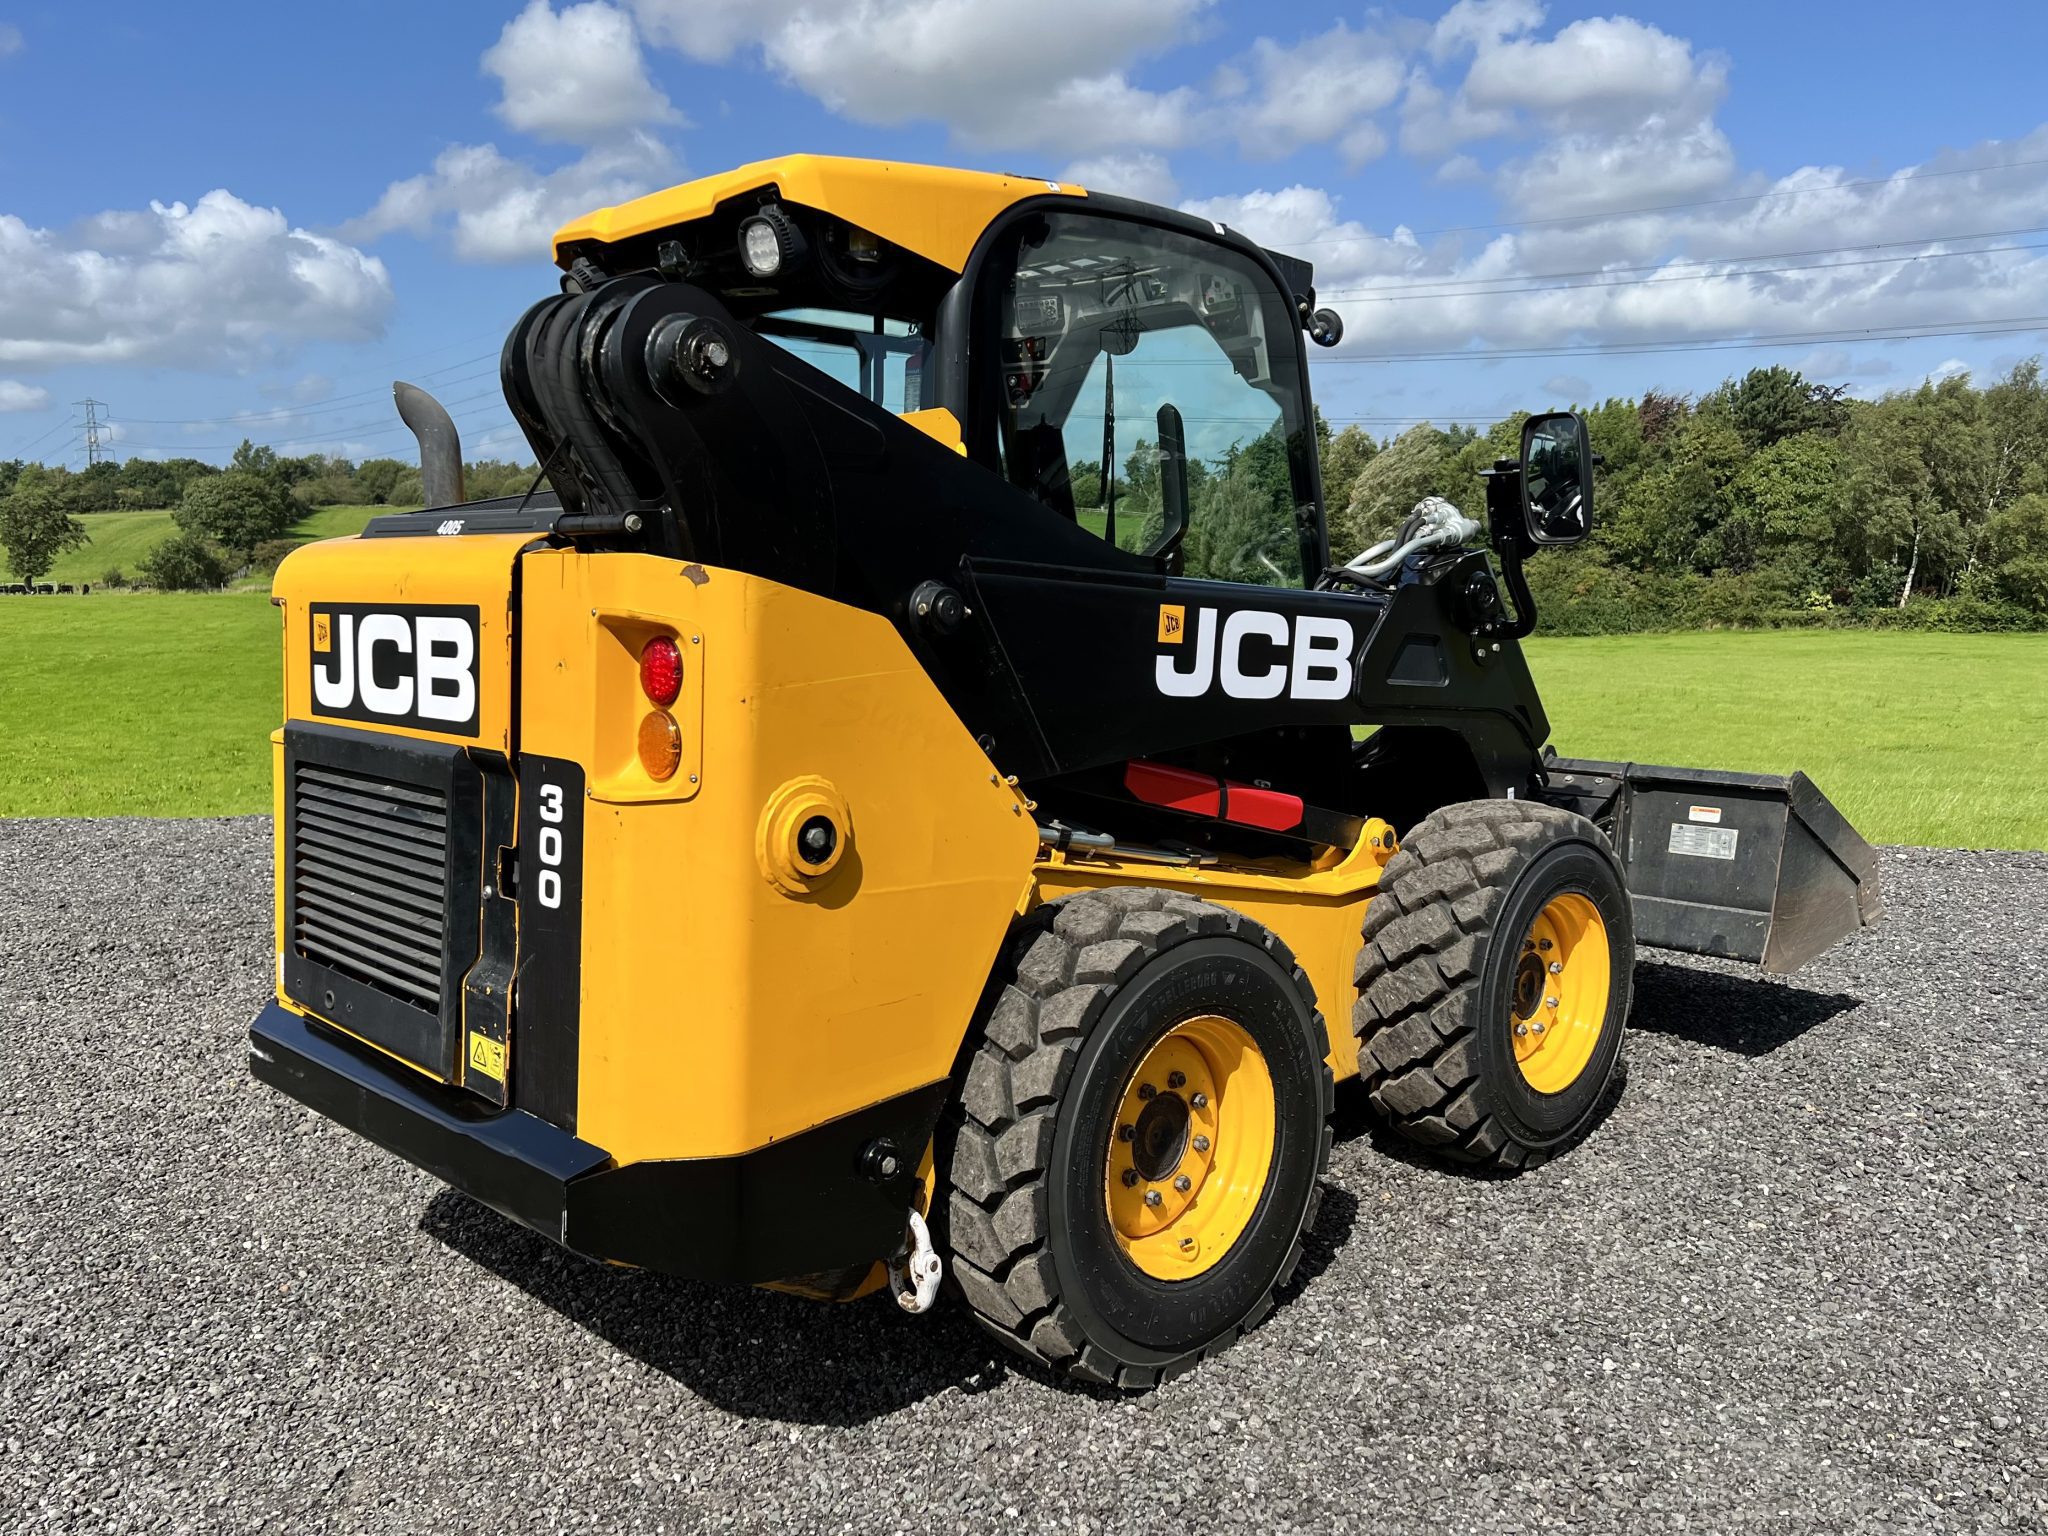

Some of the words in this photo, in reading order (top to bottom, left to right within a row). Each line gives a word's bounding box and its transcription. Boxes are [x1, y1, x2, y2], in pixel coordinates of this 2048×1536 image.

[436, 519, 466, 535] 4005
[313, 613, 476, 723] JCB
[1155, 607, 1354, 700] JCB
[1166, 614, 1180, 633] JCB
[538, 783, 563, 909] 300
